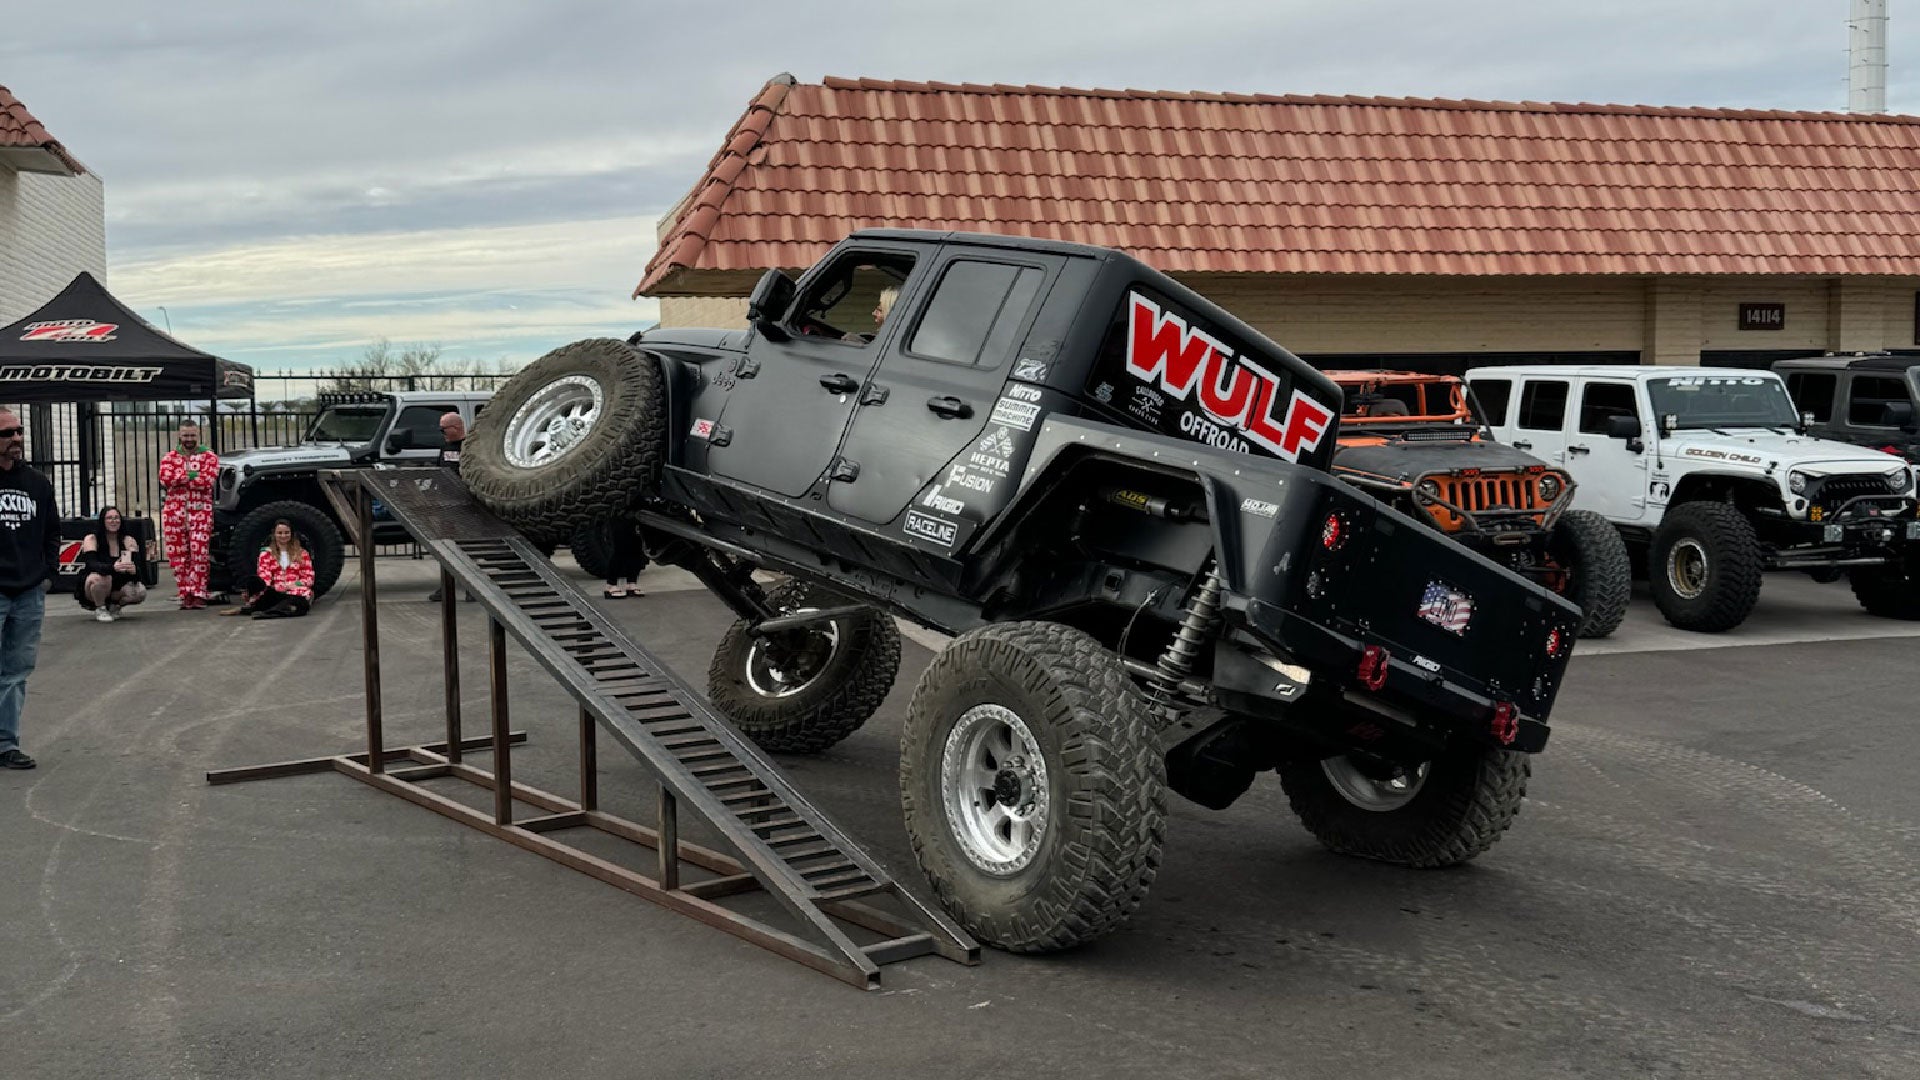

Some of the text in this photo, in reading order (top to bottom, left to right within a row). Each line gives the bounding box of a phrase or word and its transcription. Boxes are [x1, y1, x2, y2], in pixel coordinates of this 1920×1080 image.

[1746, 309, 1781, 324] 14114
[0, 365, 164, 382] MOTOBILT
[1126, 290, 1335, 464] WULF
[1667, 376, 1764, 386] NITTO
[1009, 384, 1042, 402] NITTO
[999, 400, 1038, 415] SUMMIT
[1686, 448, 1762, 463] GOLDEN CHILD
[906, 515, 955, 541] RACELINE
